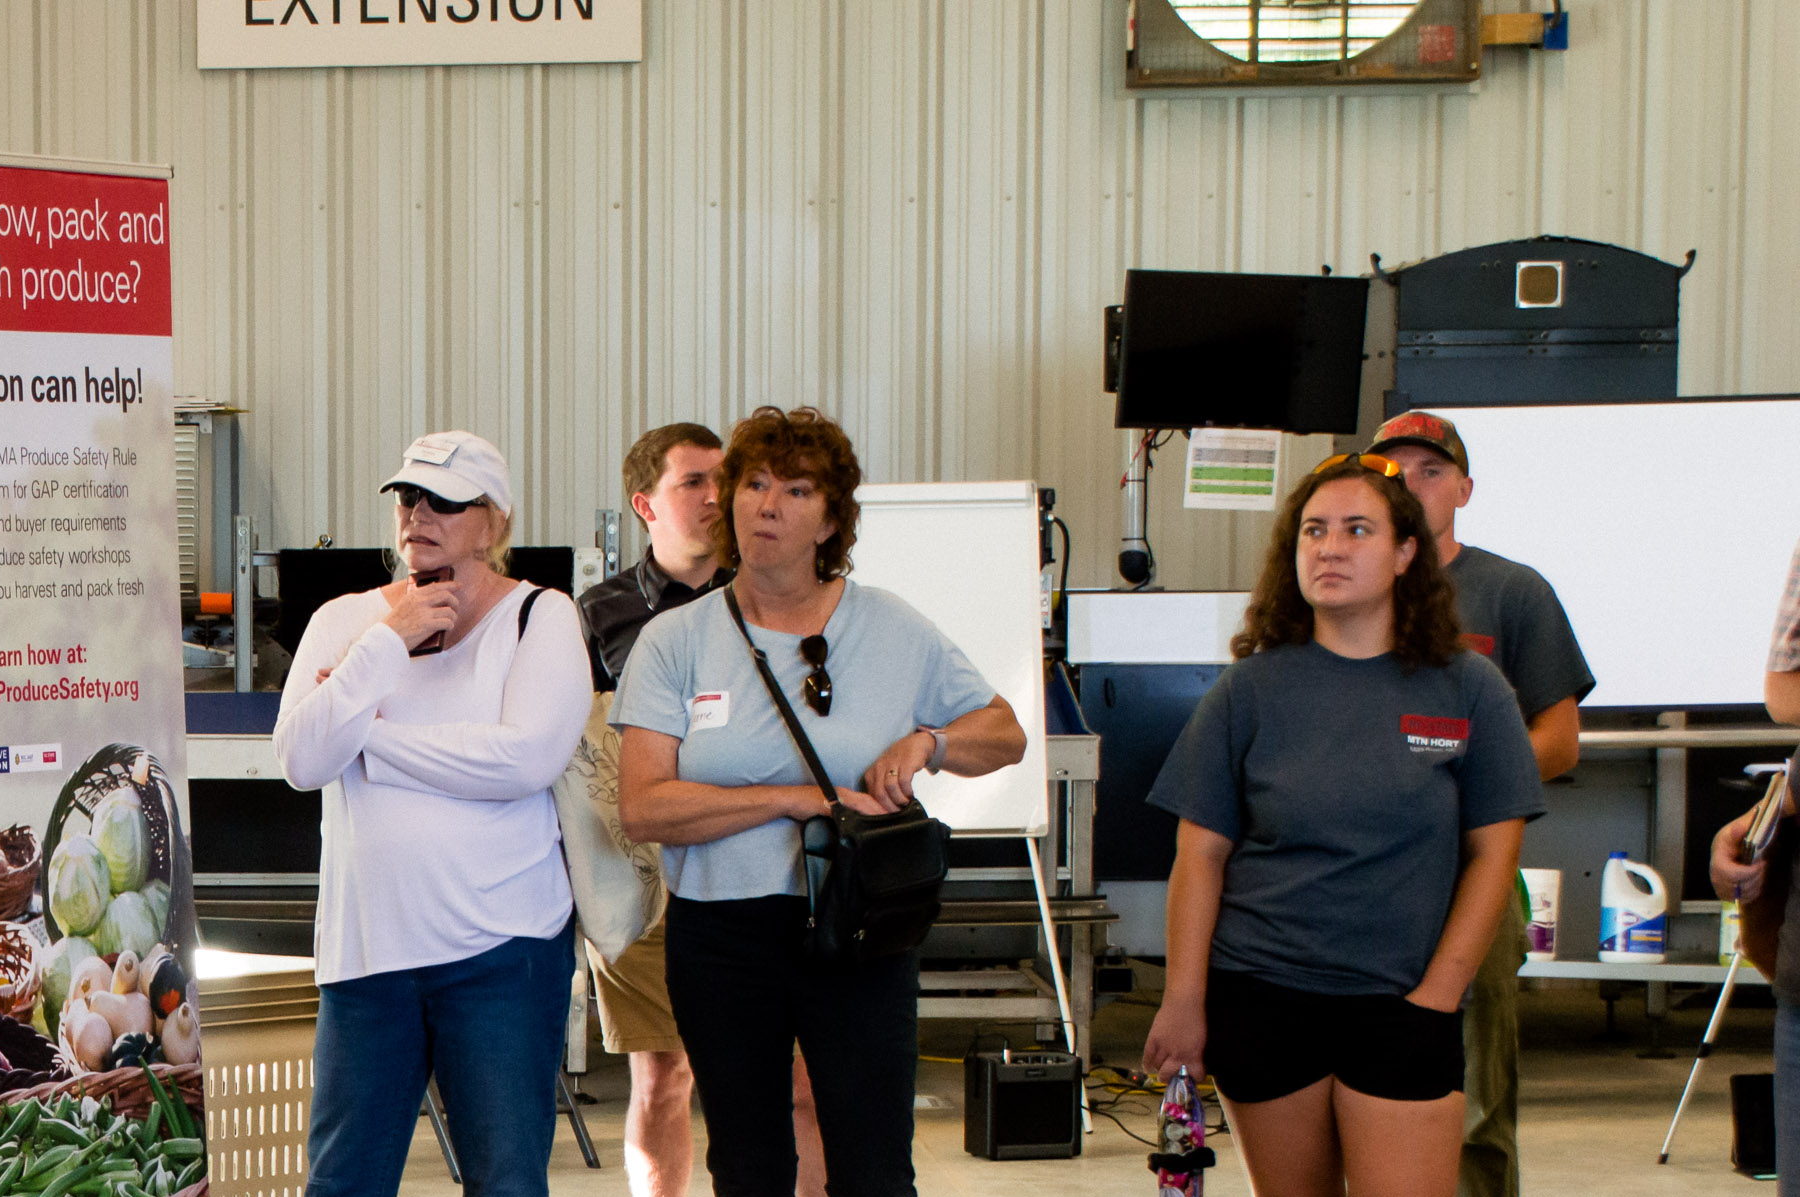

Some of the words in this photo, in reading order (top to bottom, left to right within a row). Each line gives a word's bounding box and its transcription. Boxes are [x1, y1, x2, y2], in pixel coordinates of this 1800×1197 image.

[47, 198, 110, 249] pack
[118, 202, 164, 245] and
[21, 258, 141, 311] produce?
[31, 374, 77, 403] can
[84, 365, 143, 413] help!
[20, 447, 69, 466] Produce
[72, 447, 109, 470] Safety
[112, 447, 137, 466] Rule
[12, 480, 28, 499] for
[31, 480, 59, 499] GAP
[62, 480, 129, 499] certification
[14, 514, 47, 536] buyer
[49, 513, 127, 536] requirements
[28, 546, 65, 568] safety
[68, 545, 132, 567] workshops
[14, 580, 57, 599] harvest
[60, 579, 83, 598] and
[86, 578, 114, 601] pack
[117, 577, 145, 596] fresh
[27, 643, 62, 665] how
[66, 644, 88, 664] at:
[1407, 734, 1428, 746] MTN
[1430, 738, 1460, 748] HORT
